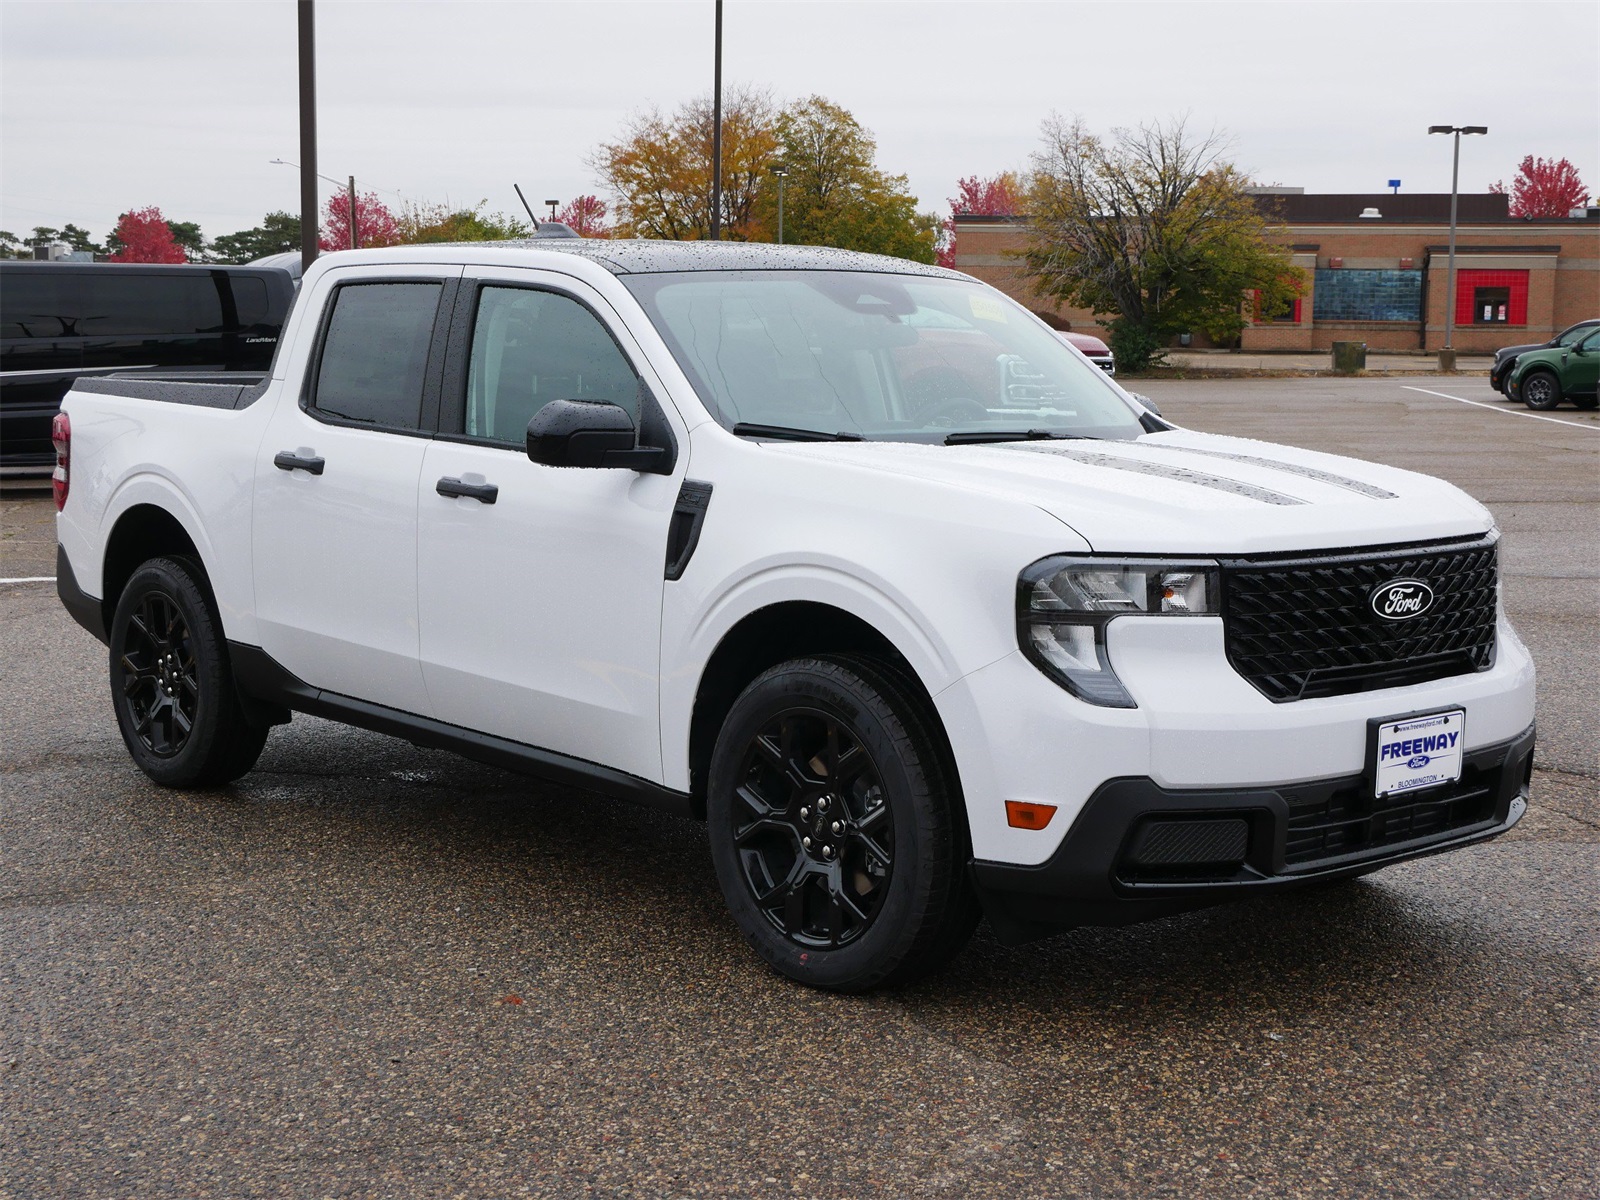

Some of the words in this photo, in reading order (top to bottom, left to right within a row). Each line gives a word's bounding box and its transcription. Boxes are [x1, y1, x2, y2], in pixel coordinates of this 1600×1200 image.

[677, 490, 706, 505] XLT
[1384, 587, 1424, 614] Ford
[1399, 719, 1443, 732] www.freewayford.net
[1380, 731, 1459, 762] FREEWAY
[1410, 757, 1427, 768] Ford
[1397, 774, 1438, 789] BLOOMINGTON
